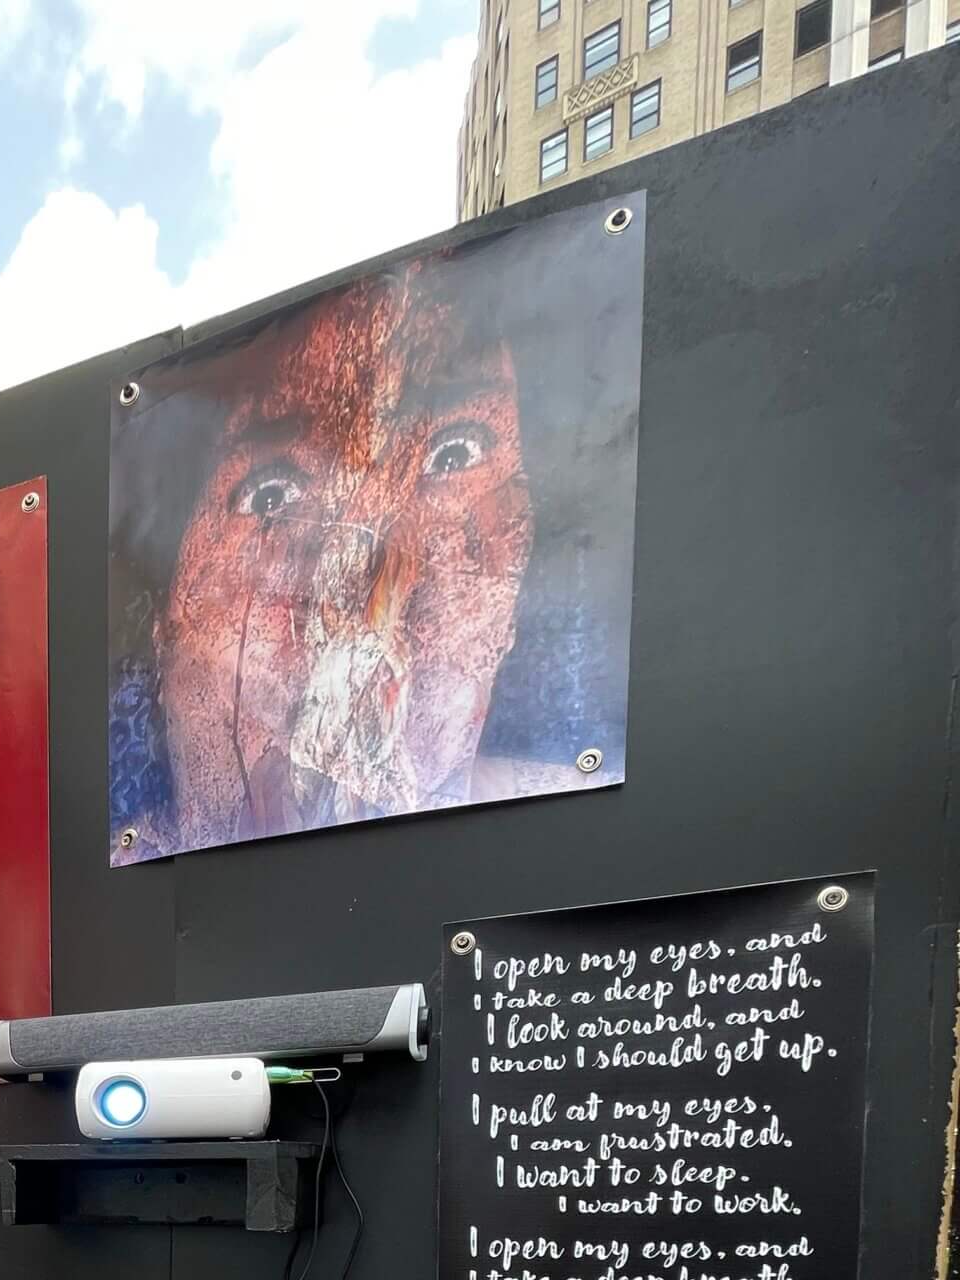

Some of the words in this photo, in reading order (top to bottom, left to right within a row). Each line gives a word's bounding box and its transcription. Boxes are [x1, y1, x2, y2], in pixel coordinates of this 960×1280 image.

[474, 948, 483, 980] I
[493, 952, 571, 992] open
[580, 949, 637, 976] my
[745, 922, 827, 951] and
[474, 993, 482, 1011] I
[491, 989, 561, 1010] take
[571, 990, 595, 1005] a
[605, 976, 674, 1009] deep
[687, 952, 823, 998] breath.
[487, 1013, 495, 1045] I
[507, 1013, 570, 1049] look
[577, 1004, 716, 1037] around,
[724, 999, 806, 1026] and
[471, 1056, 479, 1074] I
[490, 1053, 566, 1073] know
[576, 1045, 585, 1067] I
[592, 1033, 708, 1069] should
[715, 1027, 771, 1076] get
[779, 1032, 838, 1073] up.
[471, 1093, 480, 1125] I
[490, 1093, 556, 1139] pull
[565, 1092, 604, 1121] at
[613, 1099, 672, 1125] my
[510, 1133, 518, 1151] I
[530, 1134, 591, 1152] am
[599, 1115, 793, 1160] frustrated.
[496, 1155, 504, 1187] I
[516, 1156, 601, 1187] want
[608, 1156, 641, 1186] to
[649, 1158, 751, 1191] sleep.
[558, 1195, 566, 1212] I
[578, 1190, 663, 1214] want
[670, 1190, 702, 1214] to
[714, 1186, 802, 1214] work.
[469, 1225, 478, 1257] I
[488, 1236, 565, 1271] open
[574, 1239, 630, 1269] my
[735, 1236, 815, 1258] and
